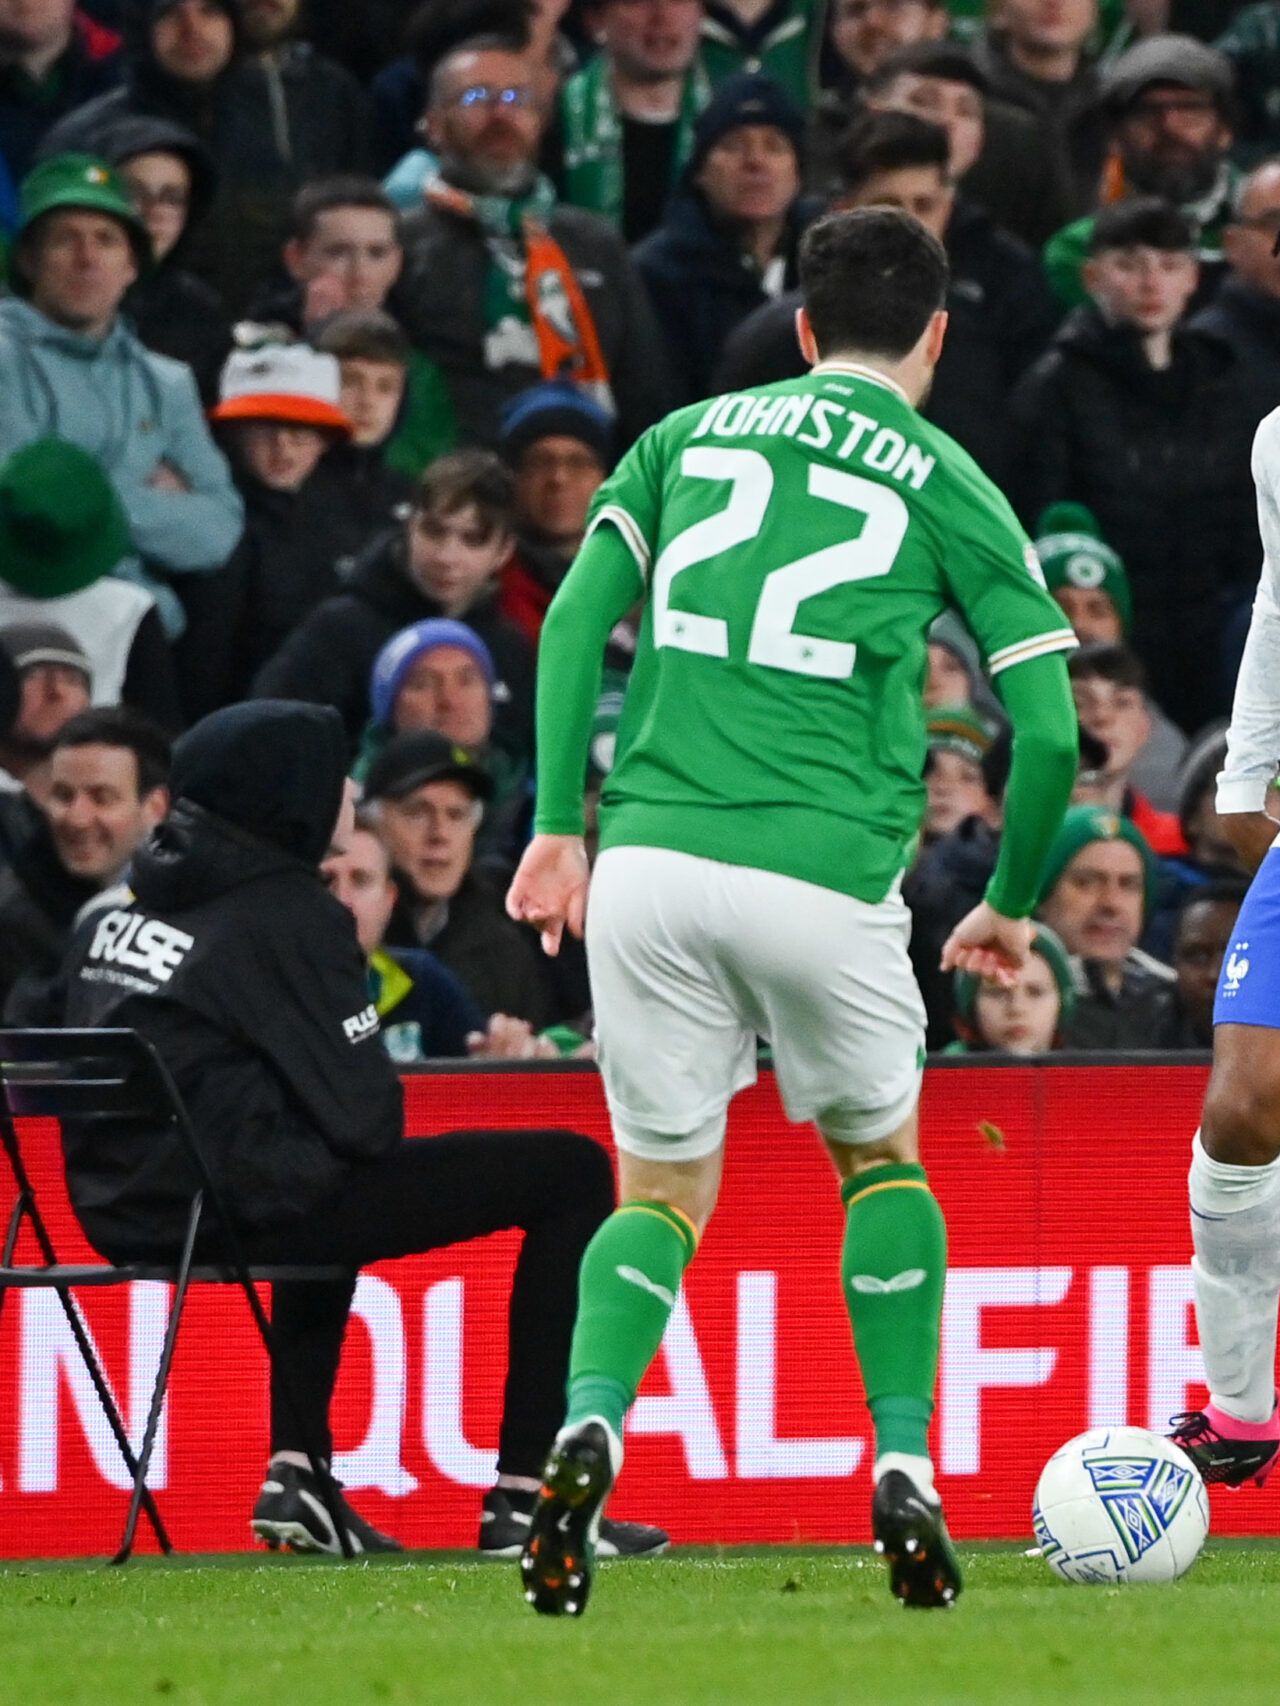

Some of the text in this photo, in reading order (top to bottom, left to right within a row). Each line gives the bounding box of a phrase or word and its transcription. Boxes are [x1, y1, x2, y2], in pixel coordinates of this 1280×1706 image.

[691, 391, 937, 491] JOHNSTON
[653, 446, 909, 679] 22
[0, 1279, 170, 1493] N
